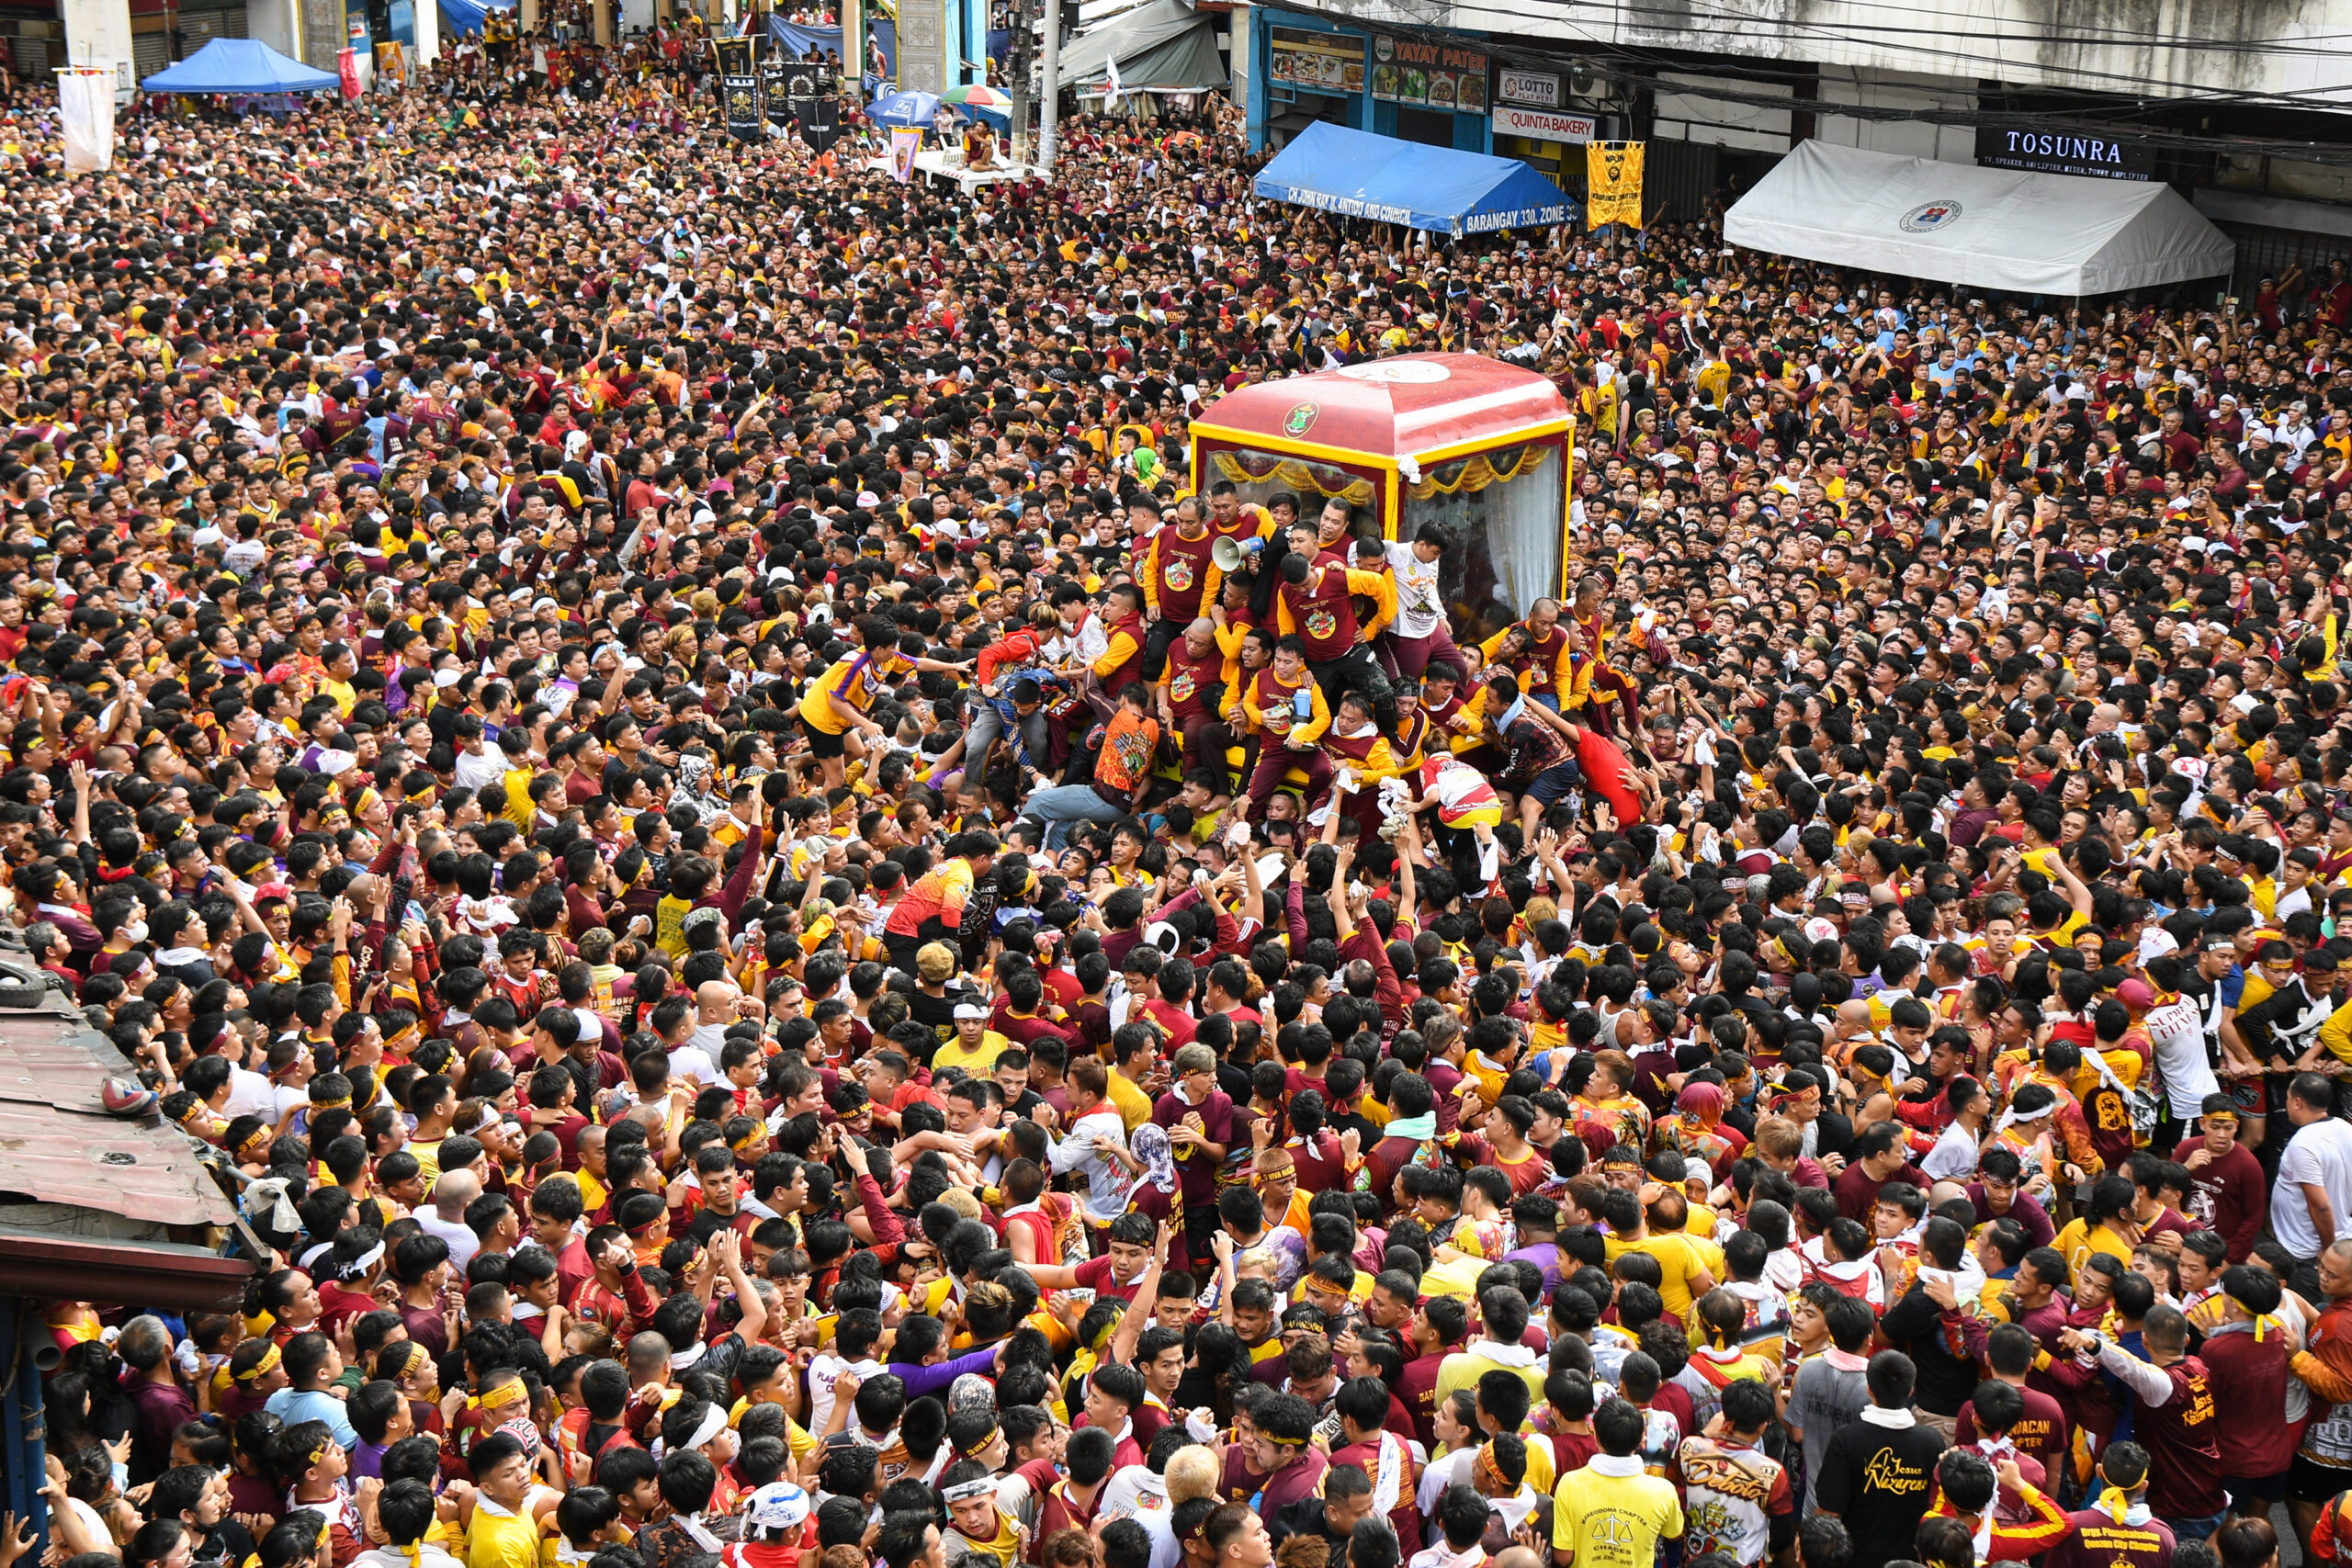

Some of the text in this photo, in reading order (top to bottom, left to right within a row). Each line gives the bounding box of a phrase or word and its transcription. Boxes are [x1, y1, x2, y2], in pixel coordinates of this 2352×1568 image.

[1395, 41, 1440, 64] YAYAY
[1518, 92, 1554, 102] PLAY HERE
[1519, 79, 1554, 94] LOTTO
[1510, 111, 1592, 136] QUINTA BAKERY
[2007, 131, 2121, 164] TOSUNRA
[1364, 202, 1379, 218] AND
[1380, 206, 1412, 226] COUNCIL
[1466, 209, 1518, 233] BARANGAY
[1540, 205, 1565, 223] ZONE
[1618, 1508, 1647, 1527] CHAPTER
[2080, 1527, 2102, 1538] Brgy.
[2084, 1539, 2161, 1553] Quezon City Chapter
